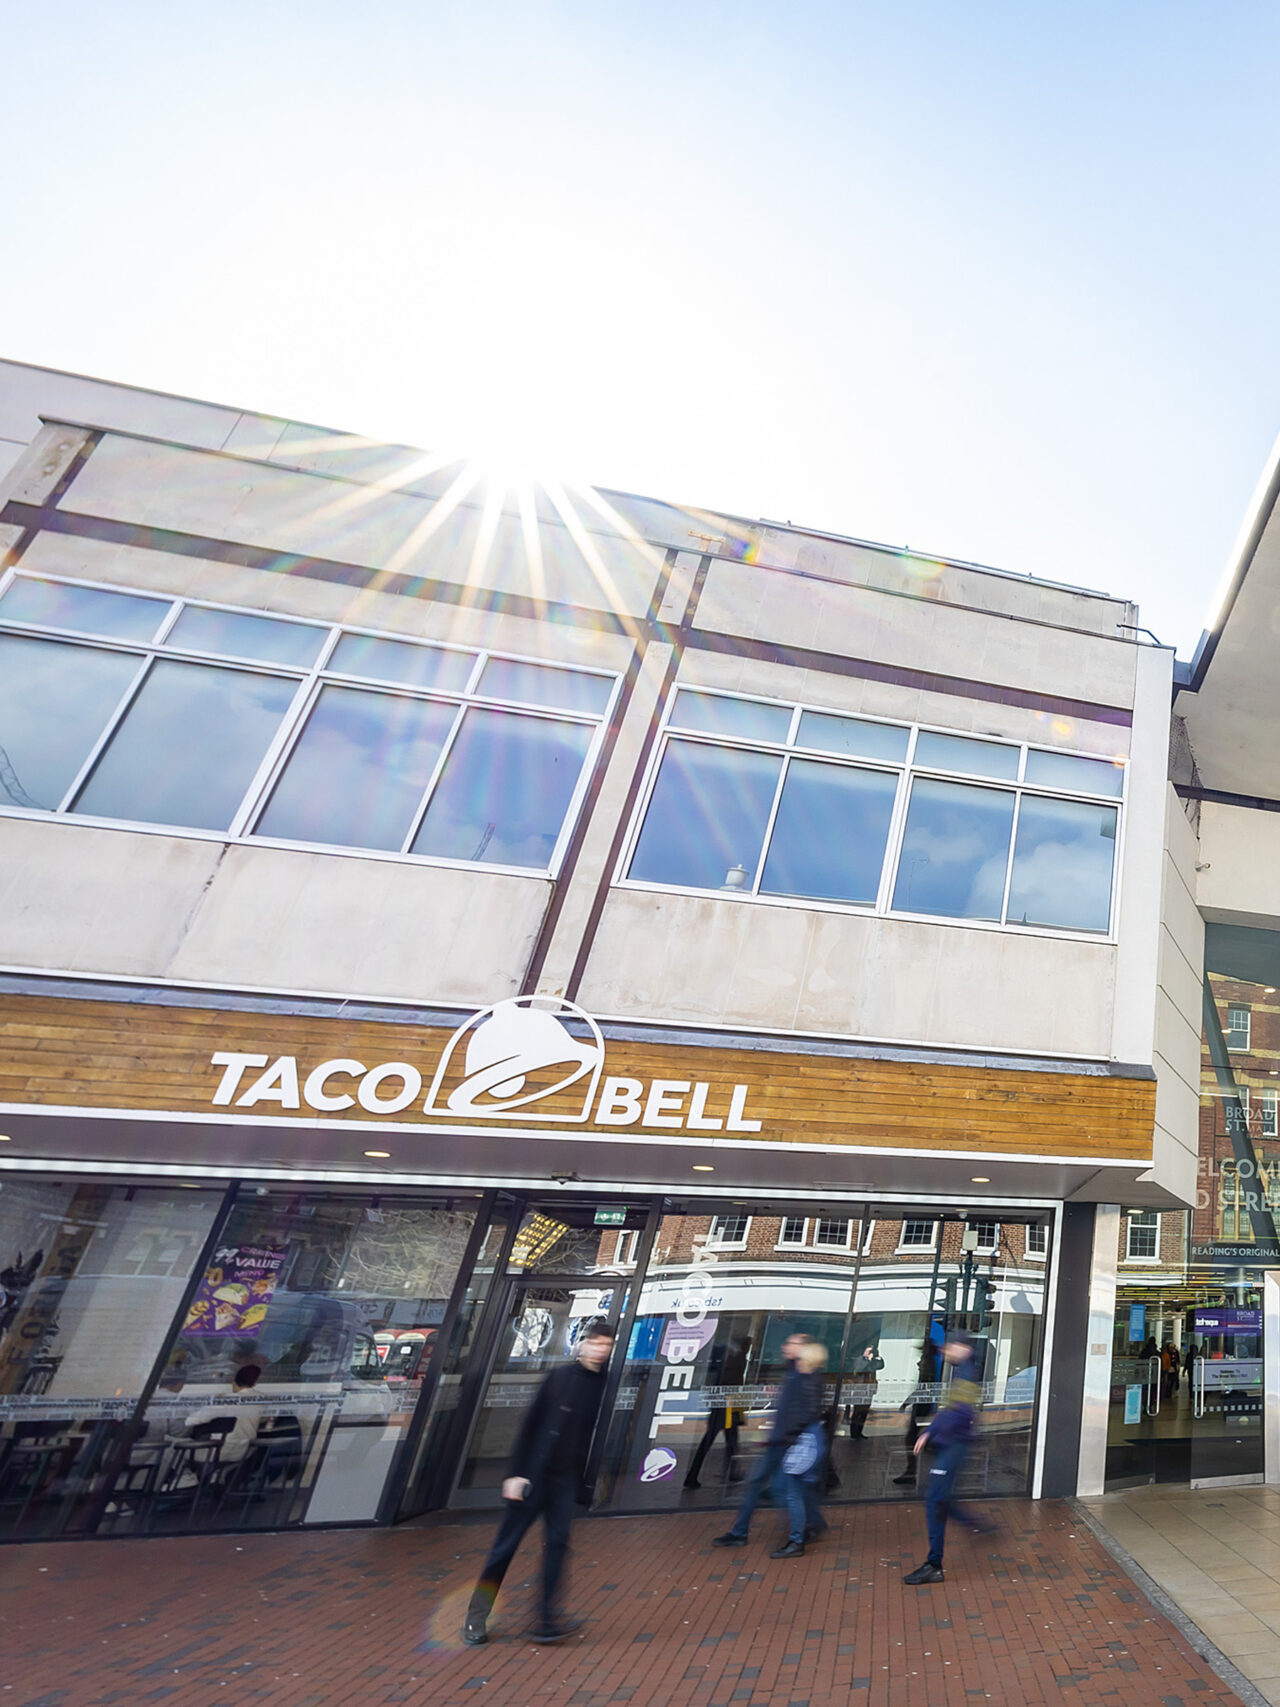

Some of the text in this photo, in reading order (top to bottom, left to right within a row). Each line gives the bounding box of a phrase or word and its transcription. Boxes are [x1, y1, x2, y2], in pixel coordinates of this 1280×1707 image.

[210, 1051, 763, 1132] TACO BELL
[1225, 1106, 1274, 1121] BROAD
[234, 1257, 282, 1270] VALUE
[1191, 1246, 1238, 1256] READING'S
[1239, 1247, 1280, 1257] ORIGINAL
[675, 1226, 726, 1328] TACO
[648, 1338, 702, 1439] BELL
